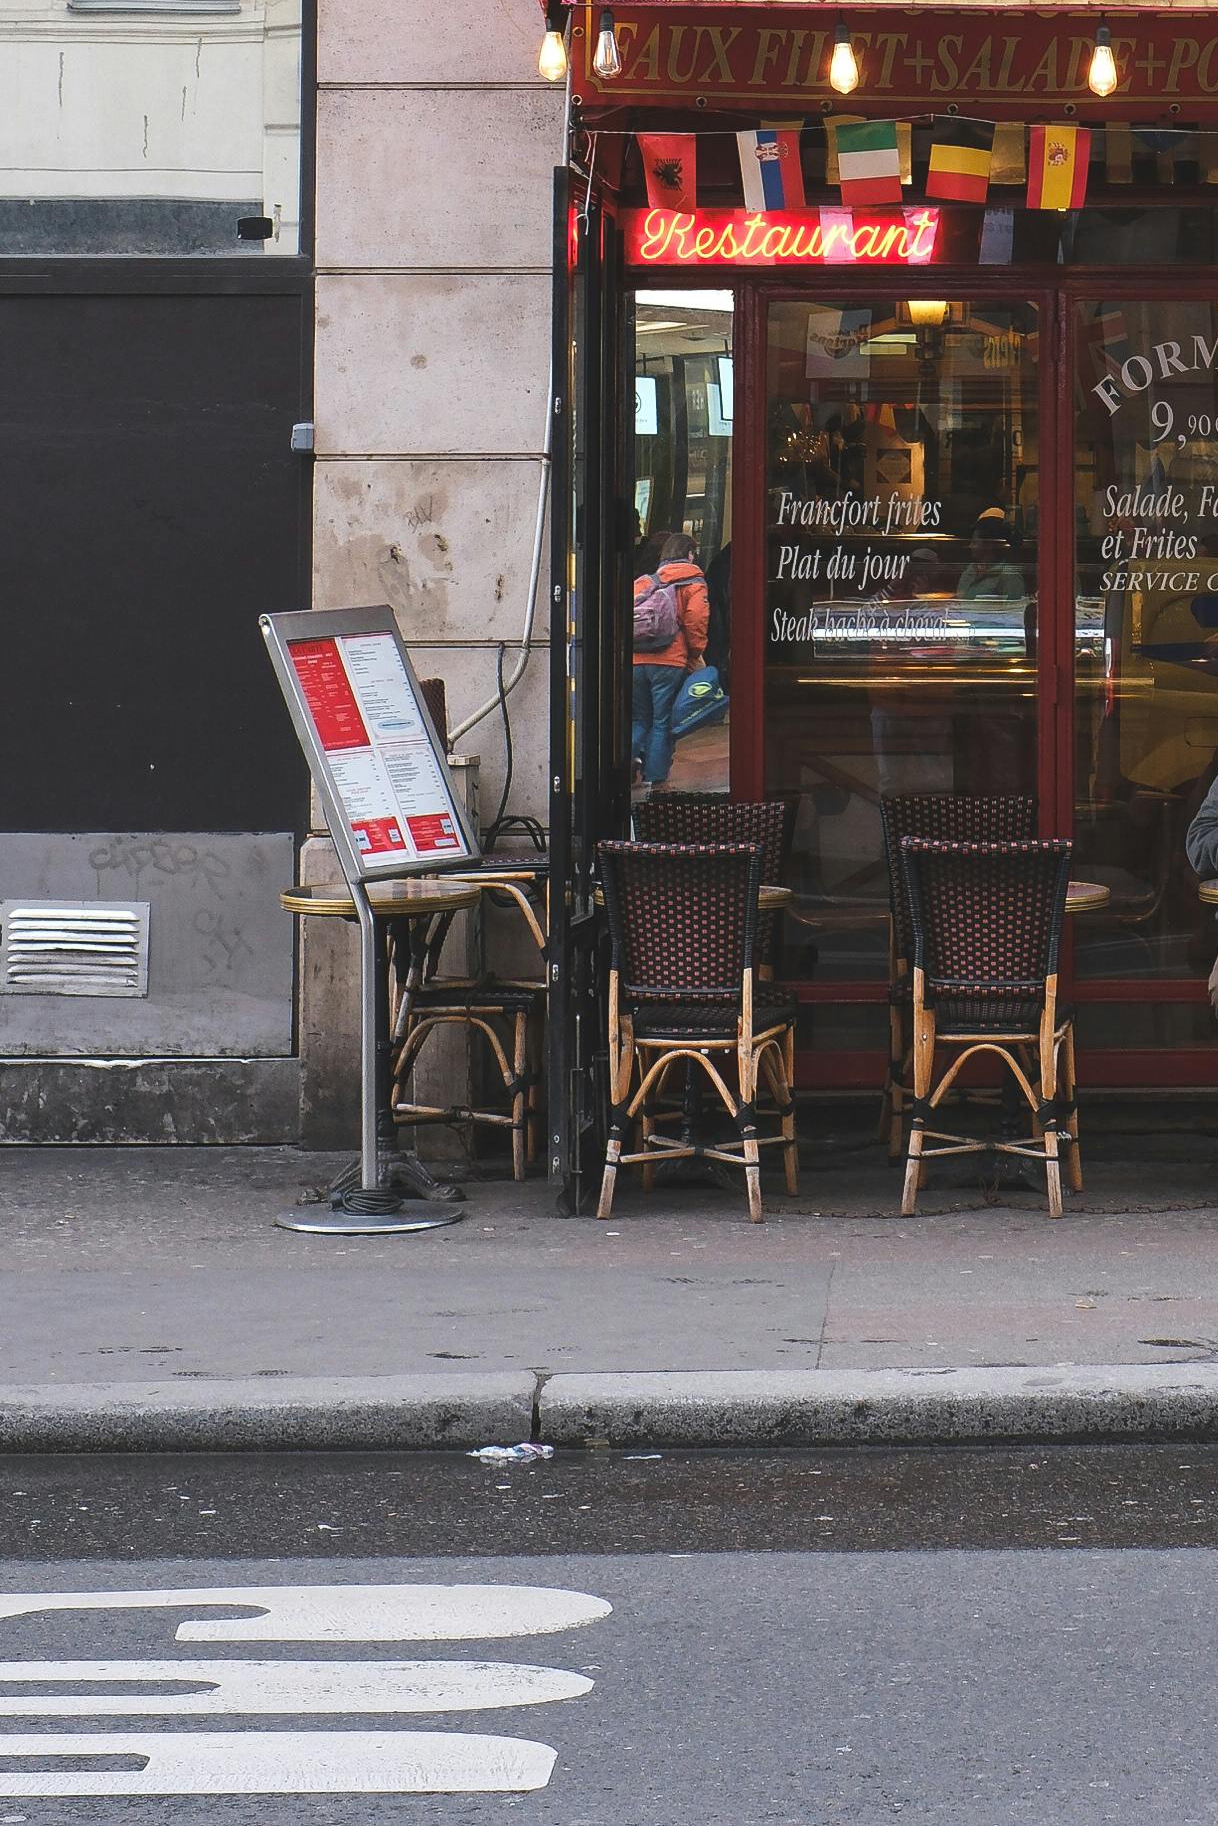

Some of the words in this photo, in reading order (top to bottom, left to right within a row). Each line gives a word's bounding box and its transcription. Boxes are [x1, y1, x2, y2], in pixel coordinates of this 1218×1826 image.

[641, 208, 935, 259] Restaurant
[776, 491, 881, 536] Francfort
[881, 491, 942, 536] frites
[1103, 485, 1189, 524] Salade,
[1101, 529, 1125, 559] et
[1131, 527, 1198, 559] Frites
[776, 545, 823, 580] Plat
[826, 546, 856, 580] du
[858, 547, 910, 591] jour
[1099, 572, 1200, 591] SERVICE
[771, 607, 819, 642] Steak
